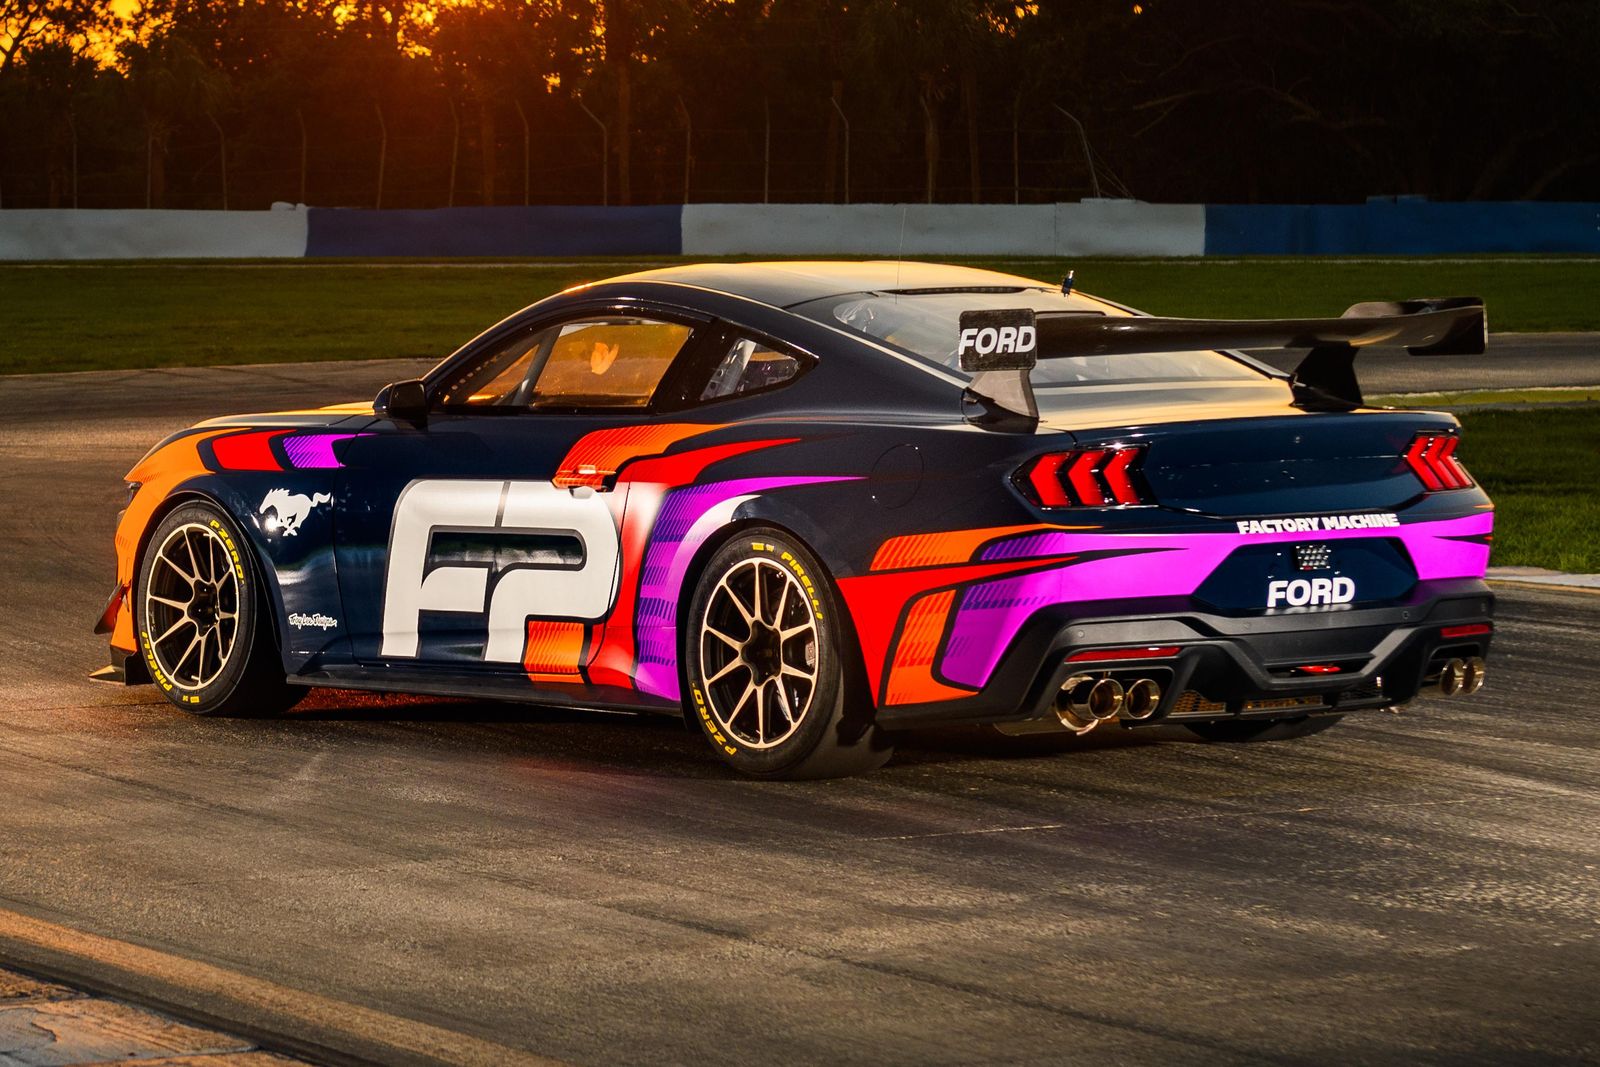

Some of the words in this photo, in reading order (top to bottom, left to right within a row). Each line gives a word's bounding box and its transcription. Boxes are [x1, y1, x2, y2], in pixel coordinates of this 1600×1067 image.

[959, 326, 1036, 355] FORD
[1236, 518, 1320, 535] FACTORY
[1321, 513, 1400, 531] MACHINE
[380, 479, 621, 663] FP
[780, 551, 824, 620] PIRELLI
[1267, 576, 1356, 608] FORD
[141, 631, 173, 692] PIRELLI
